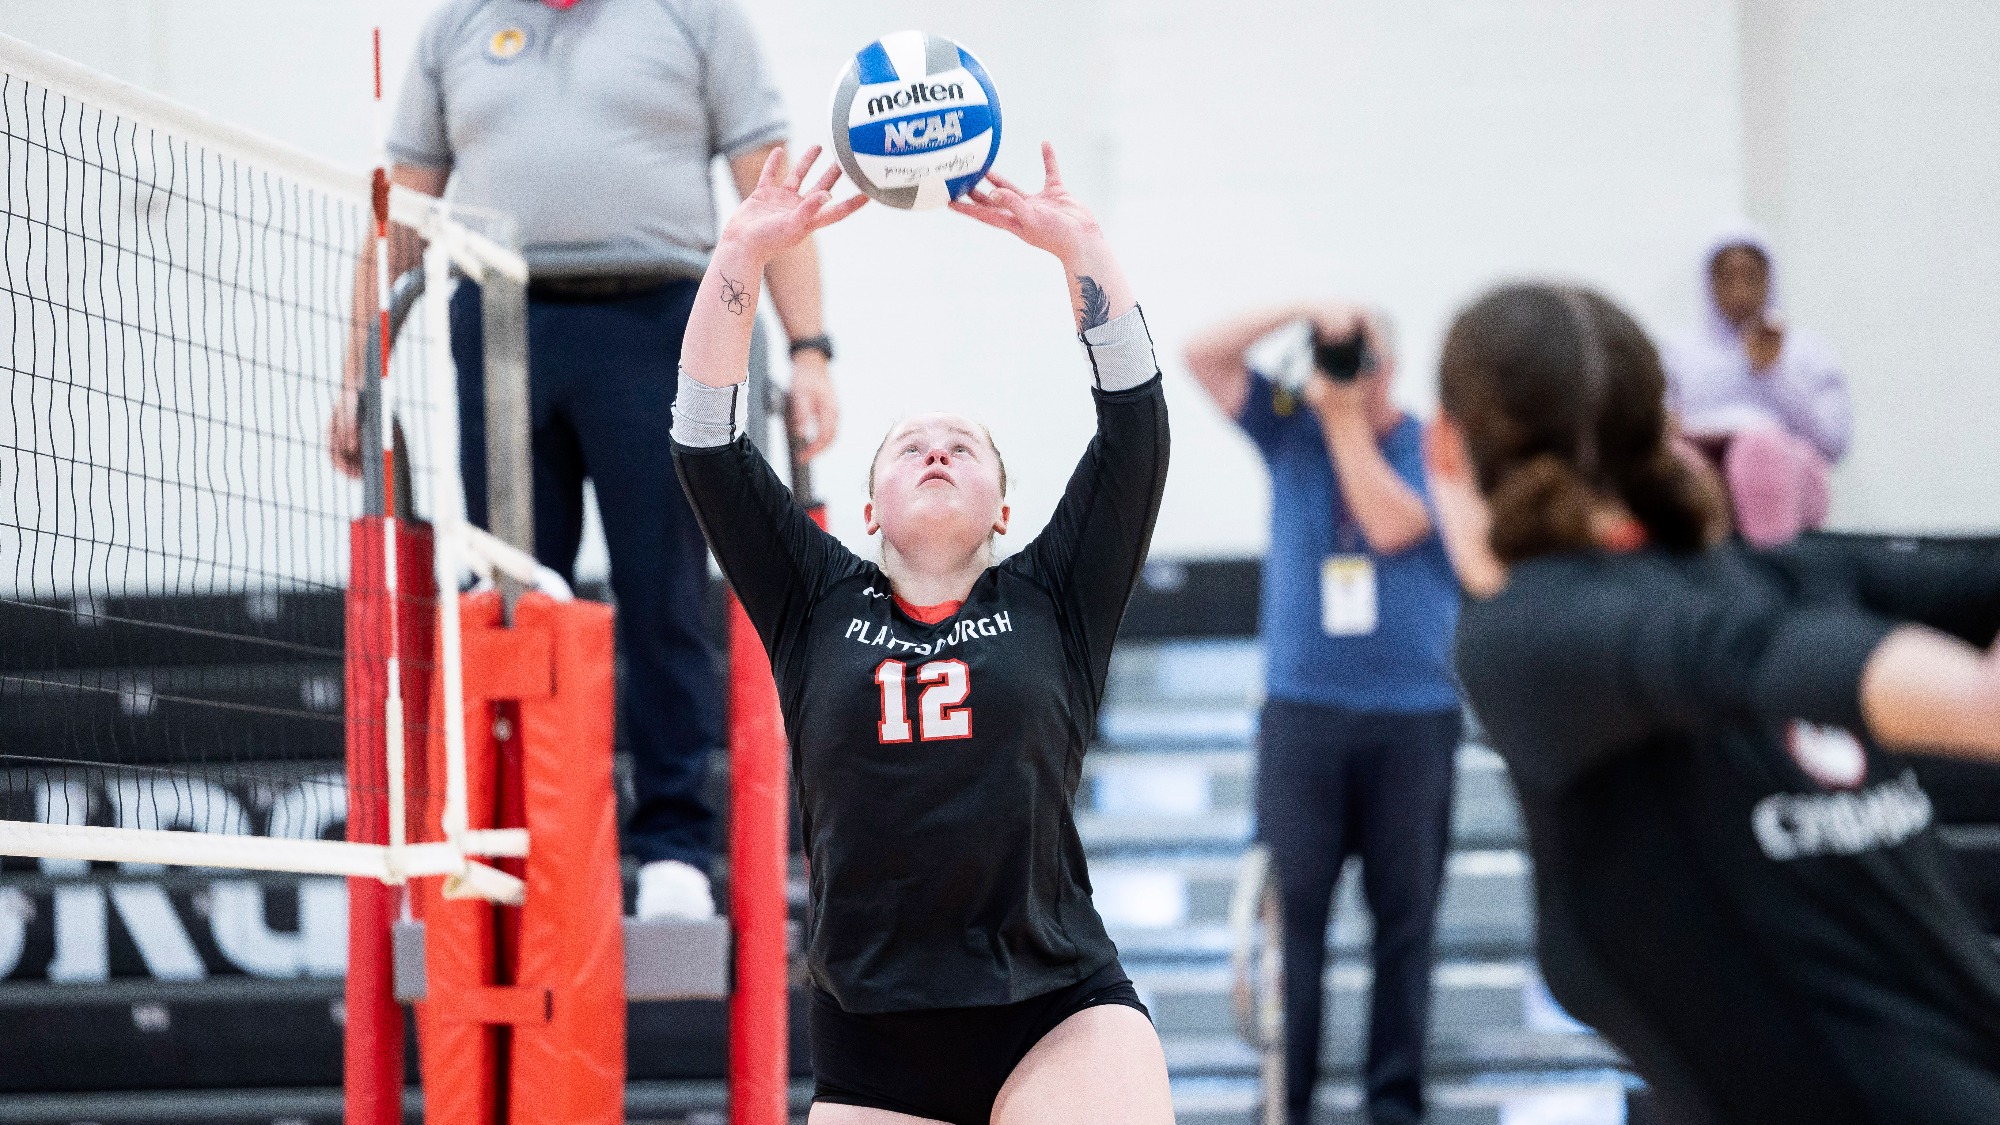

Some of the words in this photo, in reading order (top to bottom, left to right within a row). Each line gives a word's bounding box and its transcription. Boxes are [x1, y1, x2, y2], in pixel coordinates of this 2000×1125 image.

[867, 82, 965, 117] molten
[884, 111, 963, 154] NCAA
[874, 658, 973, 744] 12
